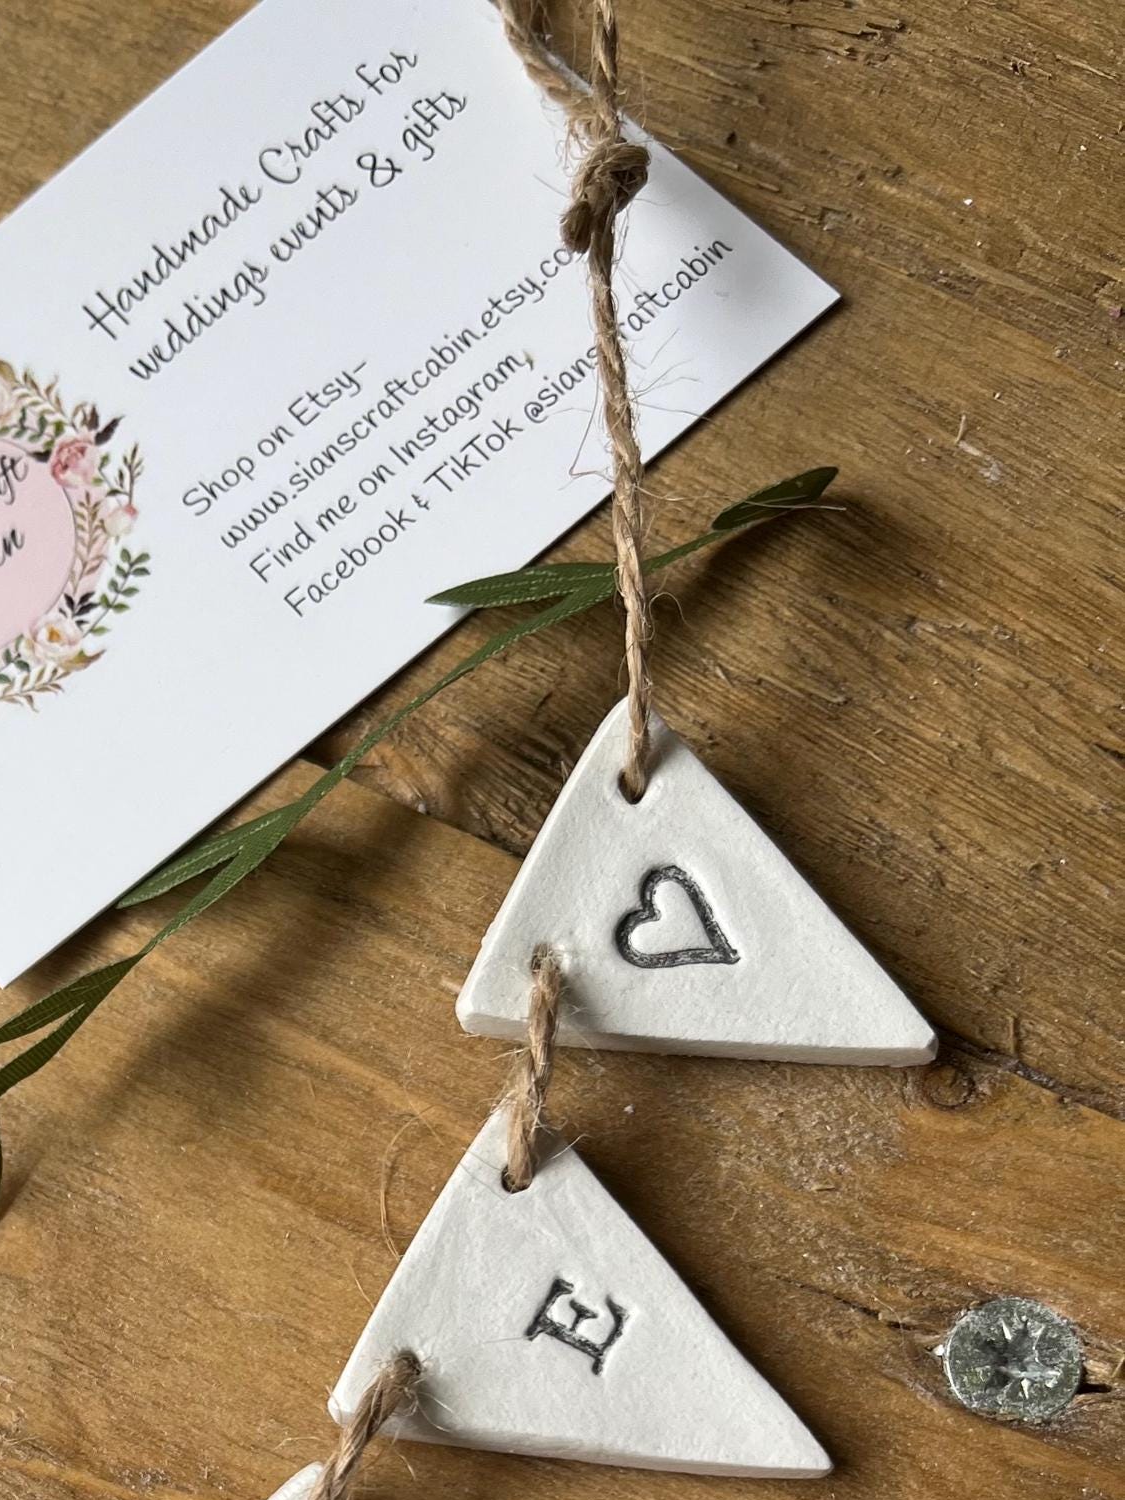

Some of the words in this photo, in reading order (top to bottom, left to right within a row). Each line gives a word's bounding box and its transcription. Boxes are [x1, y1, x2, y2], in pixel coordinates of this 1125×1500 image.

[82, 186, 262, 340] Handmade
[259, 94, 365, 185] Crafts
[356, 52, 418, 95] for
[130, 262, 269, 381] weddings
[270, 185, 359, 262] events
[357, 153, 403, 188] &
[402, 92, 467, 162] gifts
[182, 455, 256, 517] Shop
[257, 424, 295, 458] on
[288, 361, 368, 427] Etsy-
[221, 248, 576, 549] www.sianscraftcabin.etsy.co
[250, 521, 317, 583] Find
[316, 494, 357, 531] me
[358, 462, 396, 497] on
[284, 508, 416, 617] Facebook
[411, 494, 430, 511] &
[423, 418, 524, 492] TikTok
[524, 239, 733, 424] @siansraftcabin
[526, 1278, 627, 1377] E
